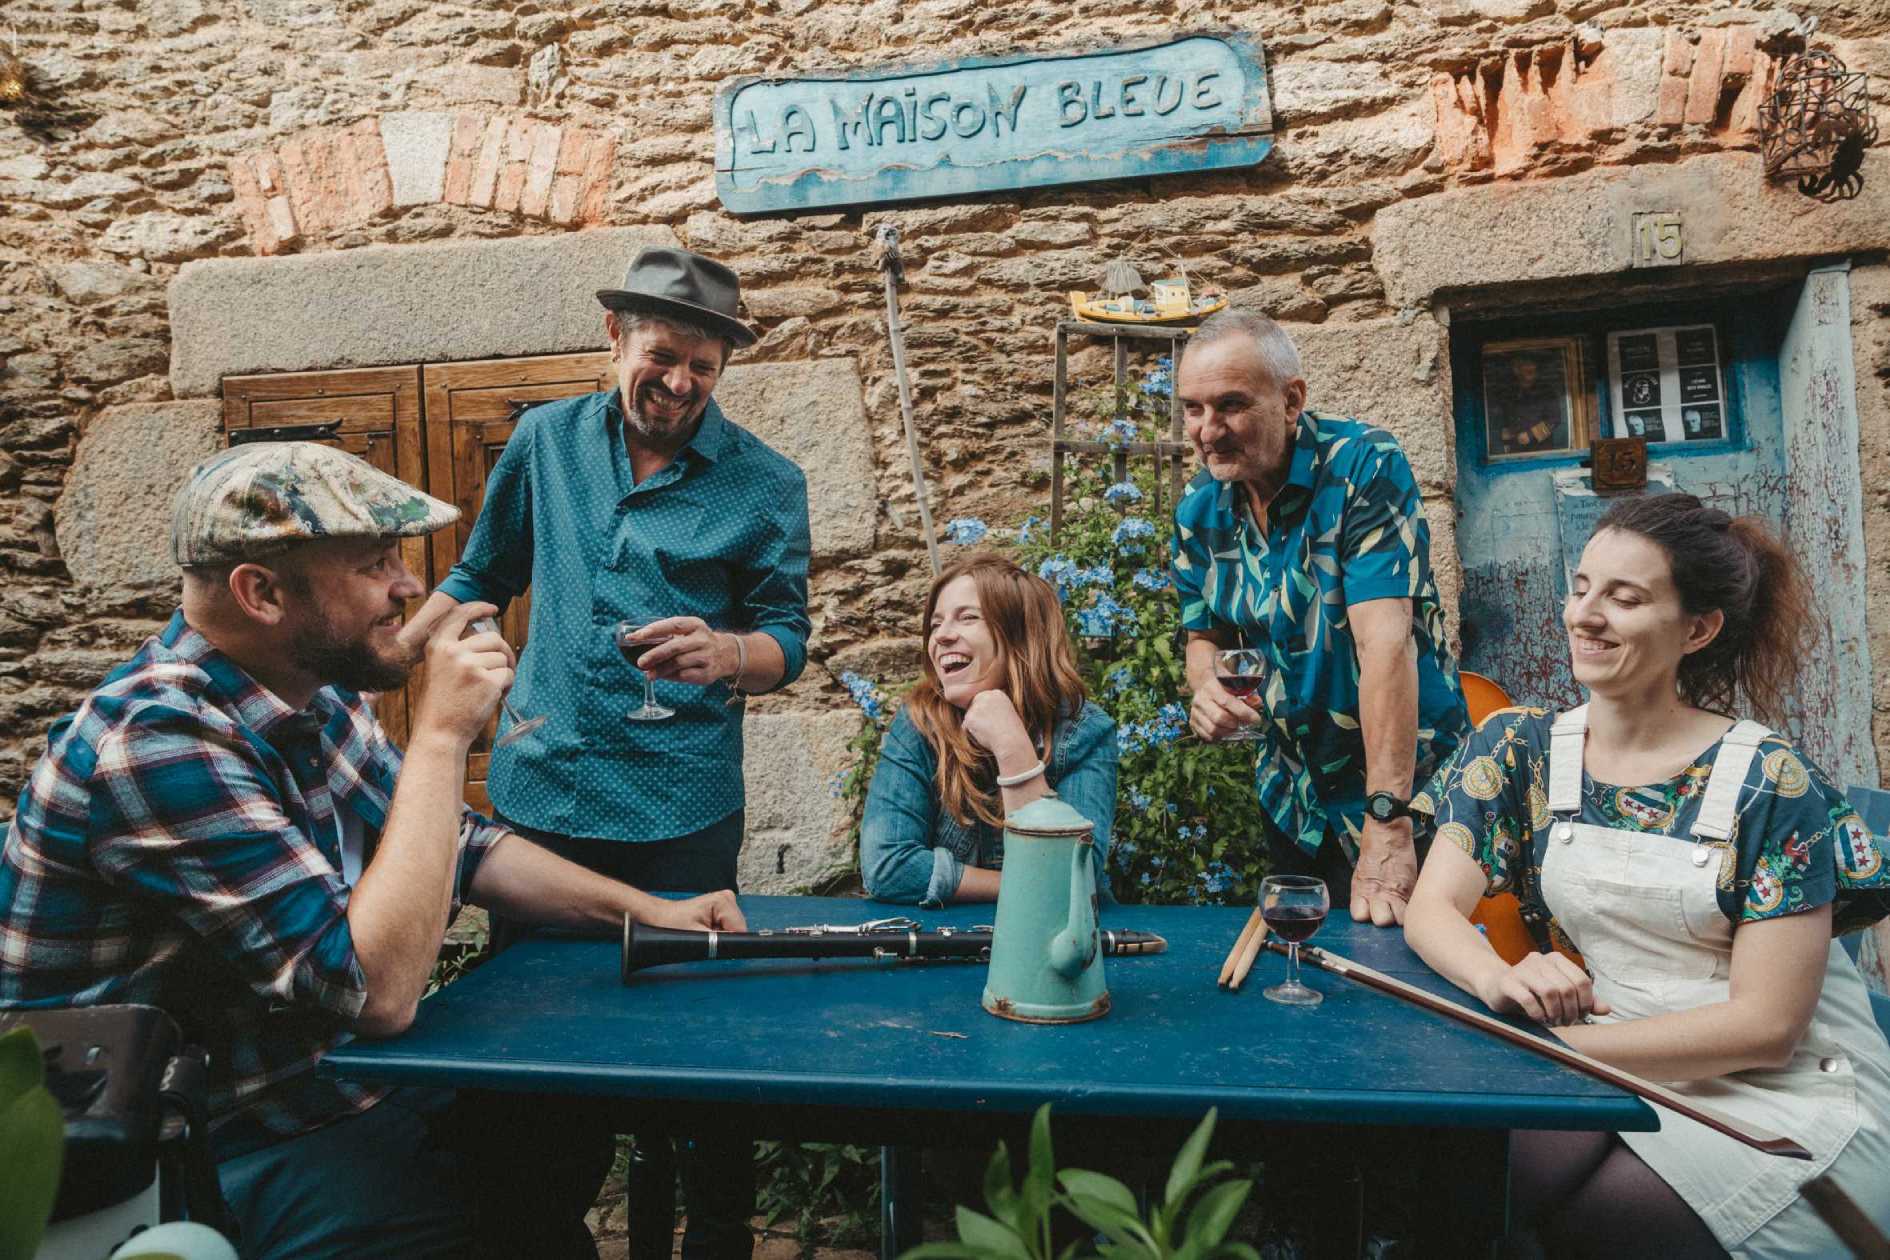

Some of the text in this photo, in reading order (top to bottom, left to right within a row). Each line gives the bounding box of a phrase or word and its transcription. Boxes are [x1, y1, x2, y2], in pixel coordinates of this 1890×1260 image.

[737, 103, 815, 155] LA
[1059, 72, 1222, 128] BLEUE
[1640, 215, 1683, 260] 15
